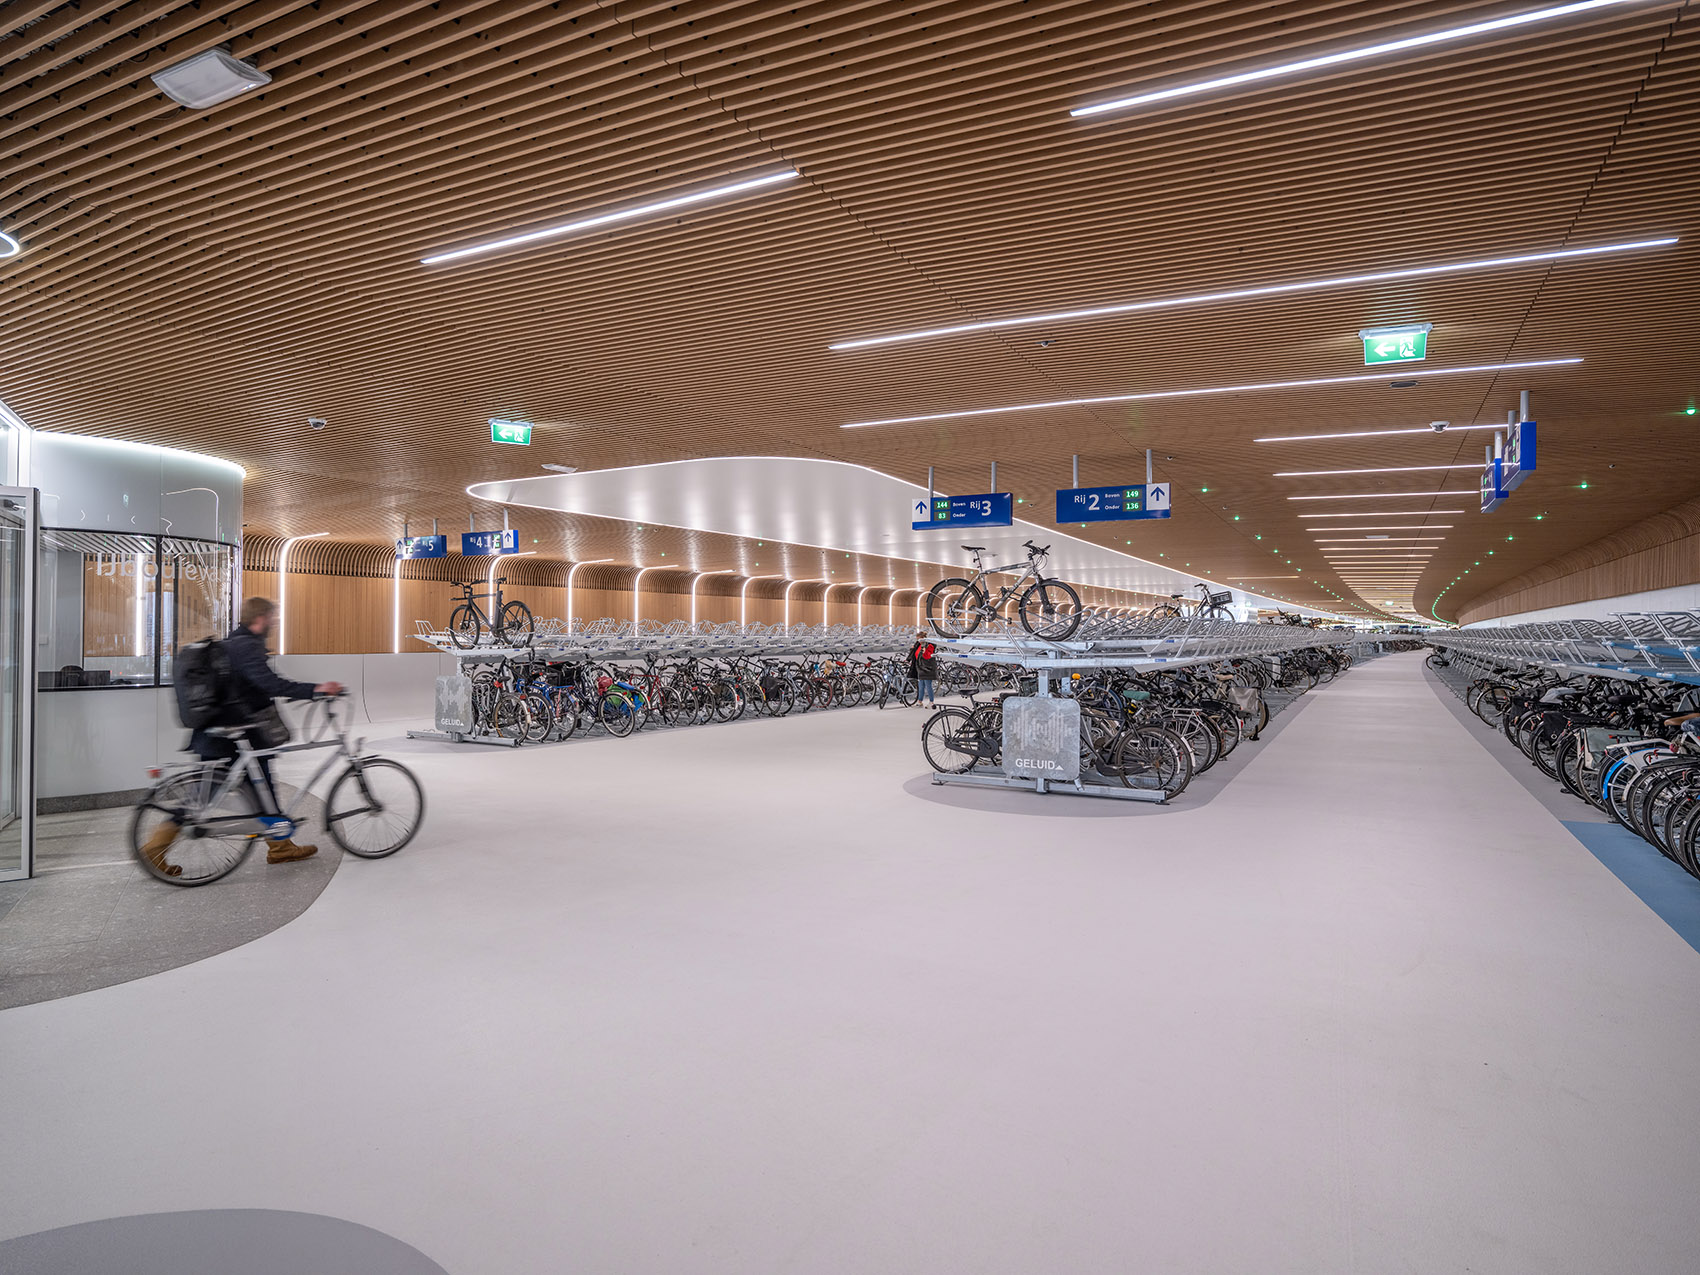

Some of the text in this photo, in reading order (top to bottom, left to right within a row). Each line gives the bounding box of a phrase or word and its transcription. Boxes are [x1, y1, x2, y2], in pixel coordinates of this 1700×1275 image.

[1126, 490, 1139, 498] 149
[969, 500, 992, 516] Rij 3
[1074, 494, 1100, 511] Rij 2
[428, 540, 434, 552] 5
[476, 536, 482, 548] 4
[440, 718, 461, 726] GELUID
[1015, 758, 1055, 770] GELUID
